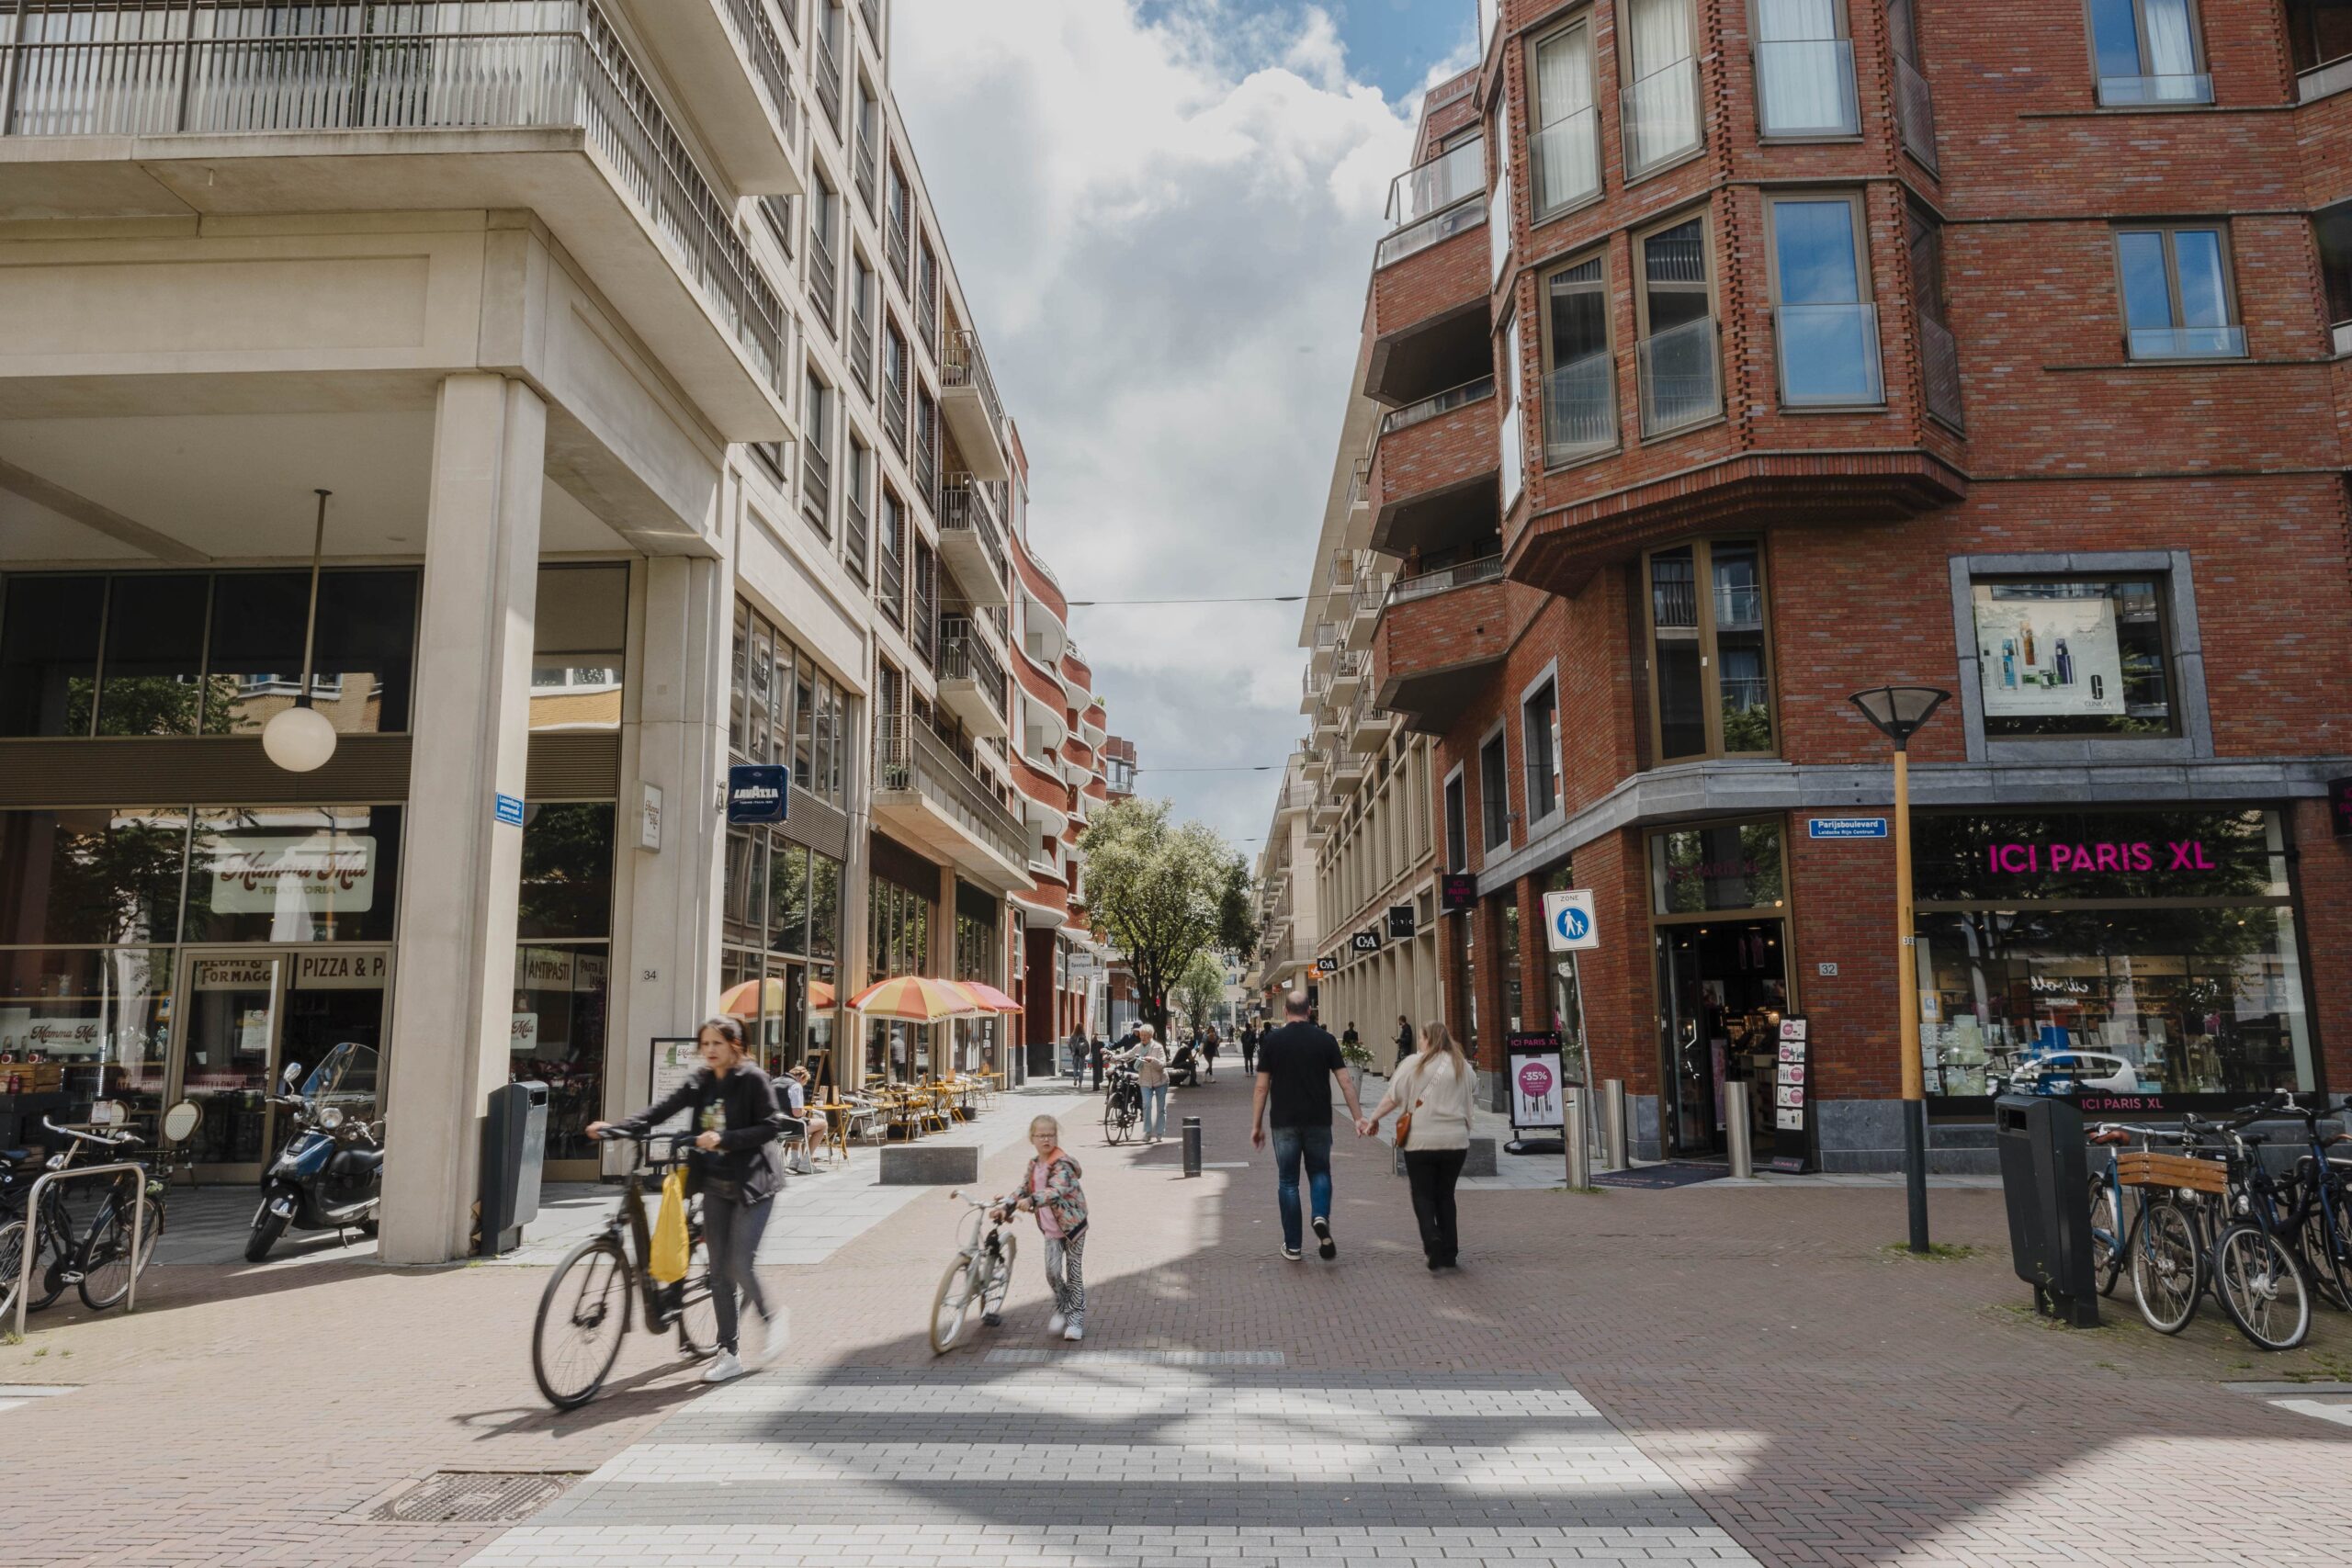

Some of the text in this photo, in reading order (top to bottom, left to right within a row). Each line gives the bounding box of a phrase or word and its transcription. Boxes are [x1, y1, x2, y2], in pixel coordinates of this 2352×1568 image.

[733, 785, 779, 799] LAVAZZA
[1817, 820, 1879, 829] Parijsboulevard
[1989, 840, 2216, 873] ICI PARIS XL
[316, 851, 368, 890] Mia
[1356, 935, 1376, 948] C&A
[302, 957, 348, 977] PIZZA
[355, 957, 366, 976] &
[528, 960, 570, 981] ANTIPASTI
[1319, 960, 1335, 970] C&A
[1822, 964, 1836, 975] 32
[644, 970, 657, 980] 34
[29, 1024, 98, 1043] Mamma Mia
[511, 1019, 533, 1039] Mia
[1523, 1038, 1545, 1046] PARIS
[1522, 1071, 1548, 1081] -35%
[2081, 1097, 2165, 1110] ICI PARIS XL
